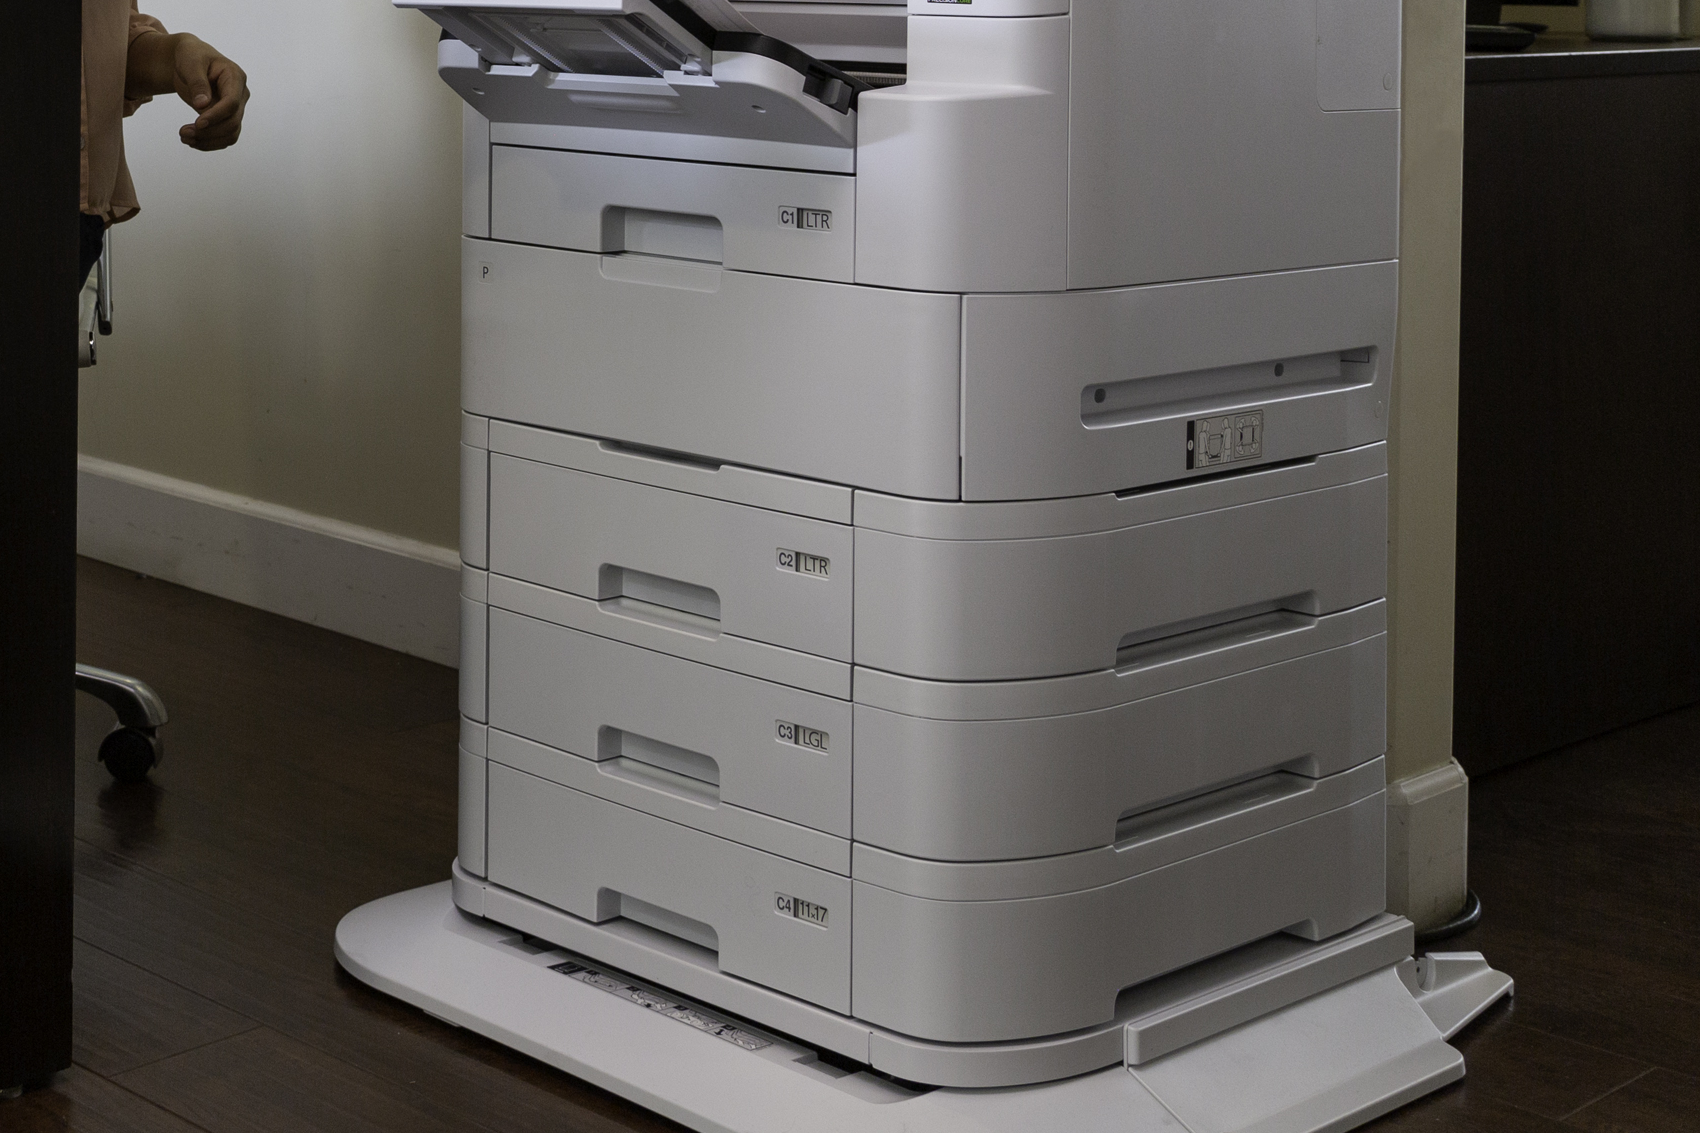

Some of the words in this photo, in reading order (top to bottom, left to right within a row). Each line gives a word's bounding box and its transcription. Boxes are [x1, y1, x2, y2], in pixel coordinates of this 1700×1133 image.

[781, 210, 794, 224] C1
[806, 212, 830, 229] LTR
[482, 266, 489, 279] P
[778, 552, 794, 567] C2
[804, 556, 829, 575] LTR
[778, 724, 793, 739] C3
[803, 728, 828, 750] LGL
[776, 896, 792, 912] C4
[800, 900, 828, 922] 11x17
